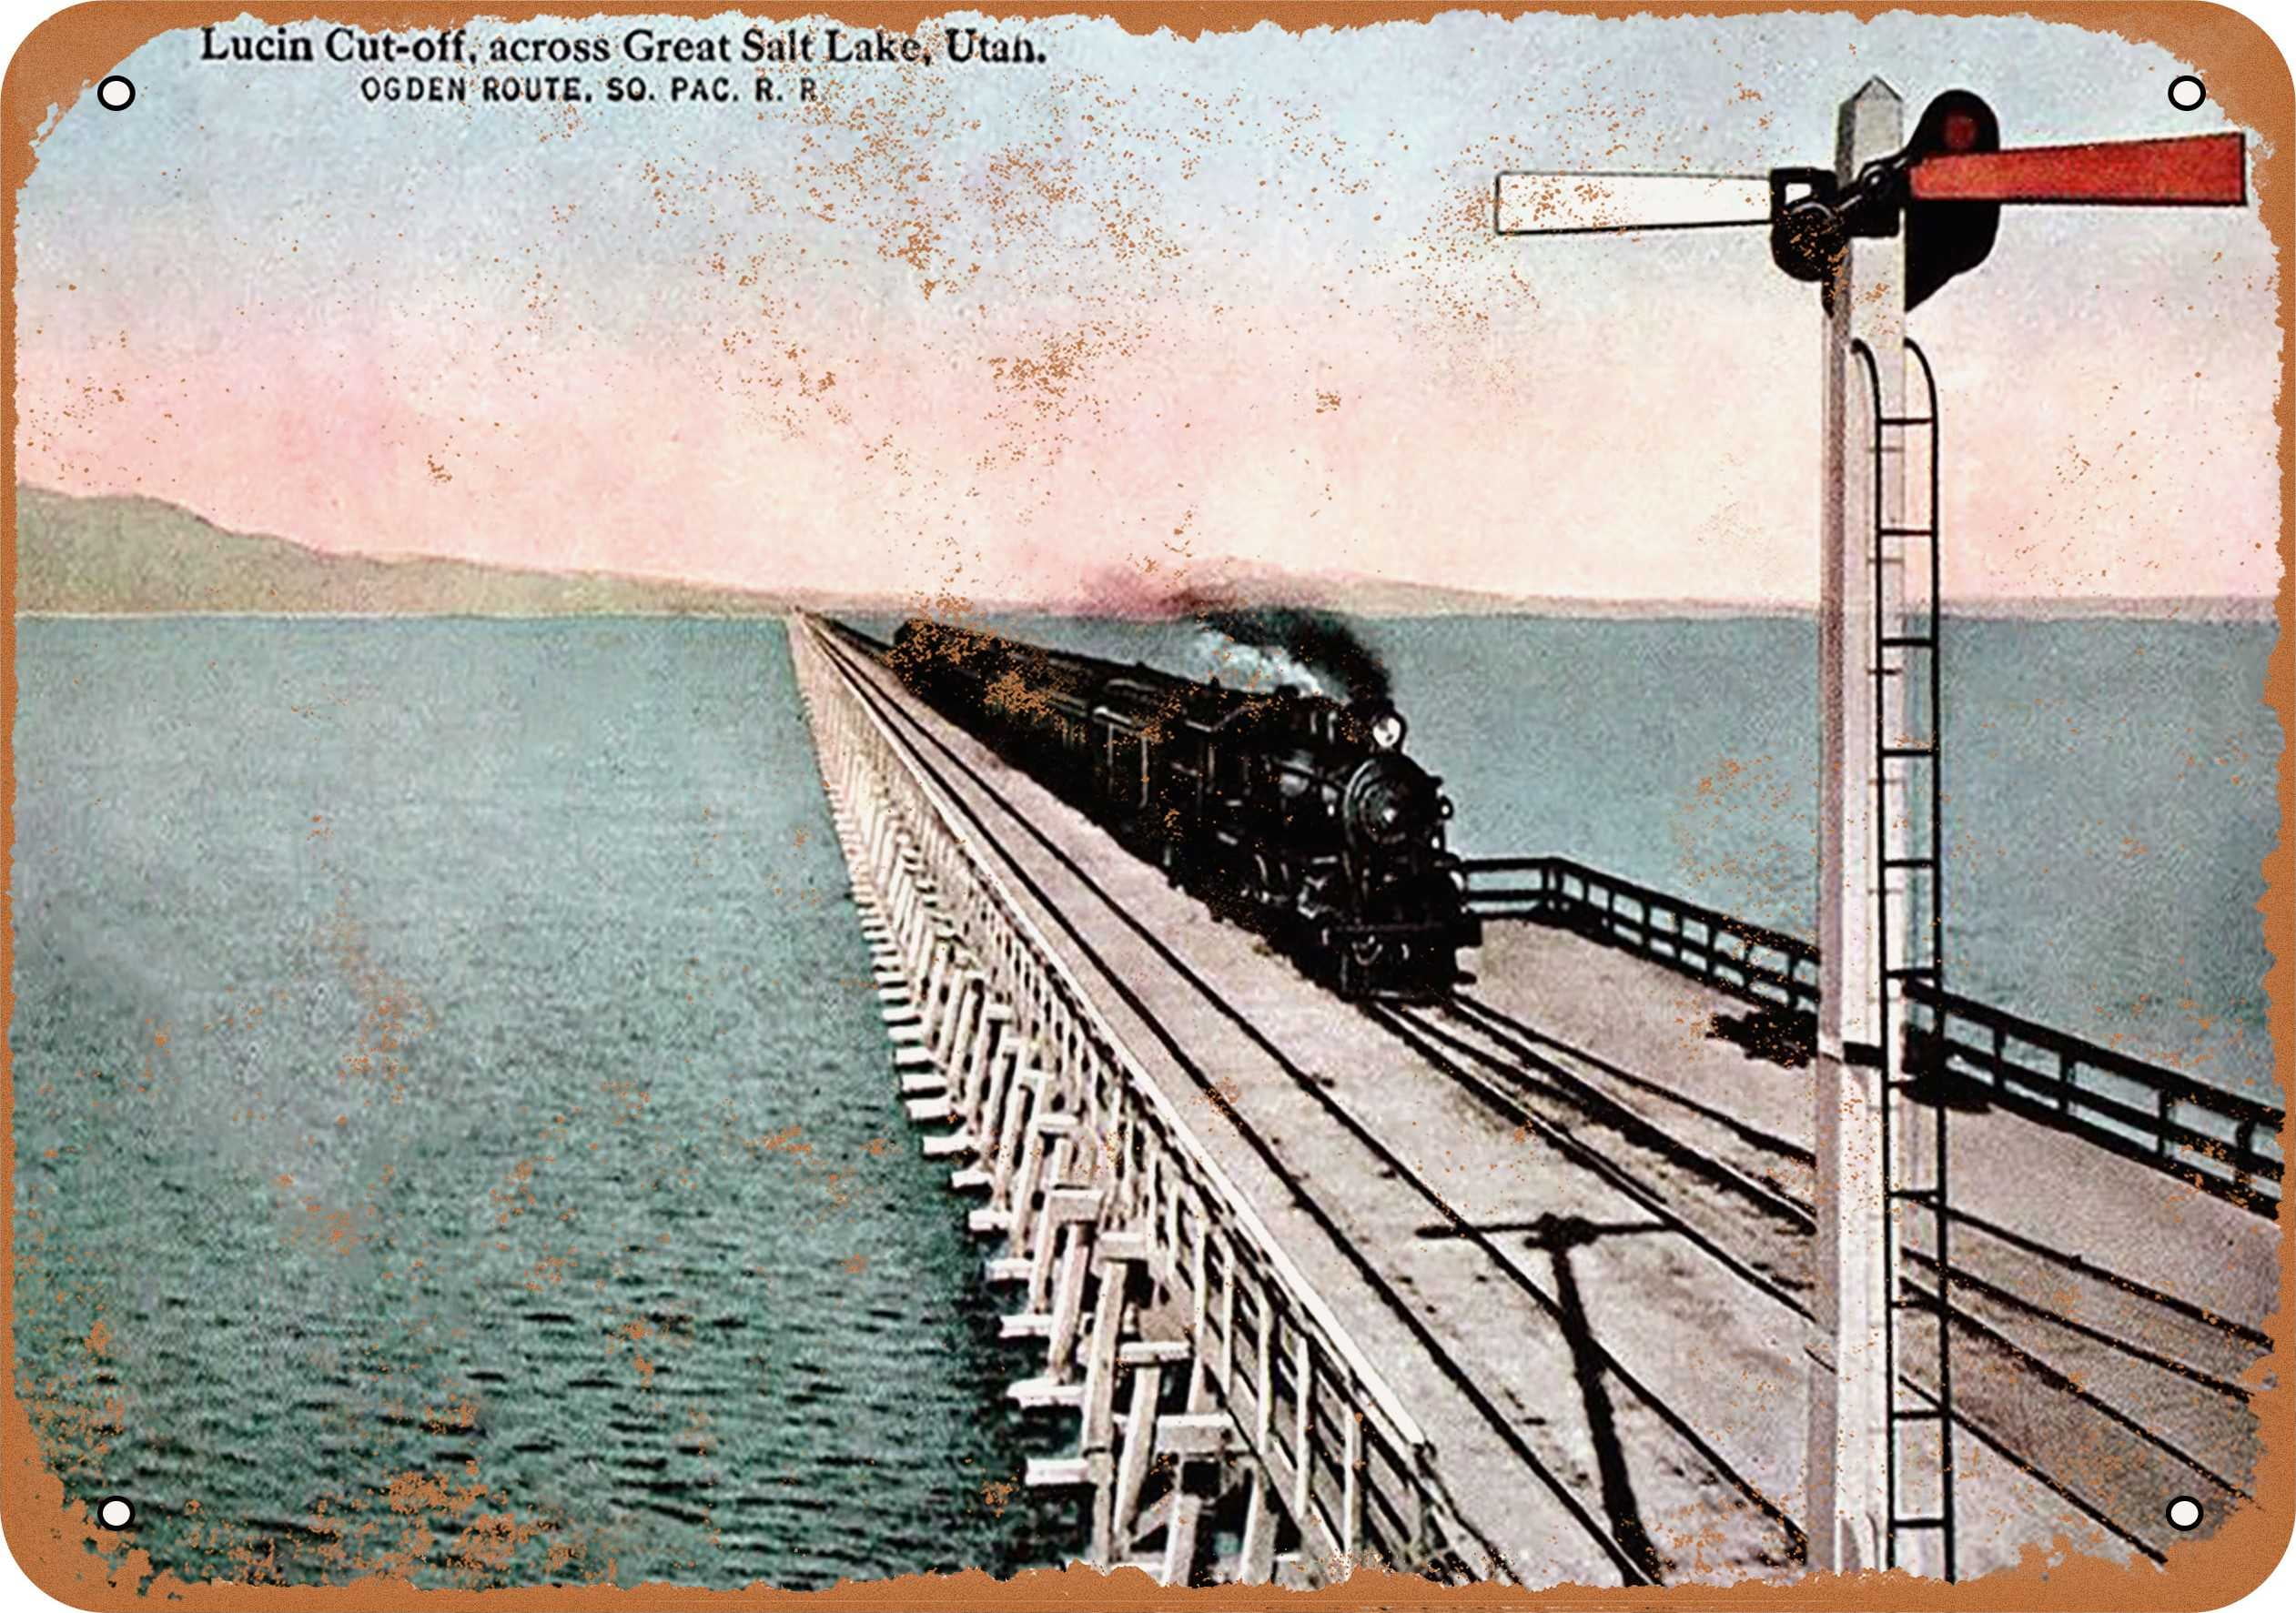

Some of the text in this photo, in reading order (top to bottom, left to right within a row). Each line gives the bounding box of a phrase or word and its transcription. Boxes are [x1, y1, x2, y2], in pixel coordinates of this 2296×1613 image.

[200, 25, 314, 62] Lucin
[325, 25, 478, 66] Cut-off,
[489, 36, 611, 63] across
[622, 28, 732, 63] Great
[741, 27, 814, 63] Salt
[825, 28, 933, 68] Lake,
[360, 76, 466, 103] OGDEN
[605, 76, 655, 103] SO.
[671, 76, 739, 103] PAC.
[754, 76, 784, 103] R.
